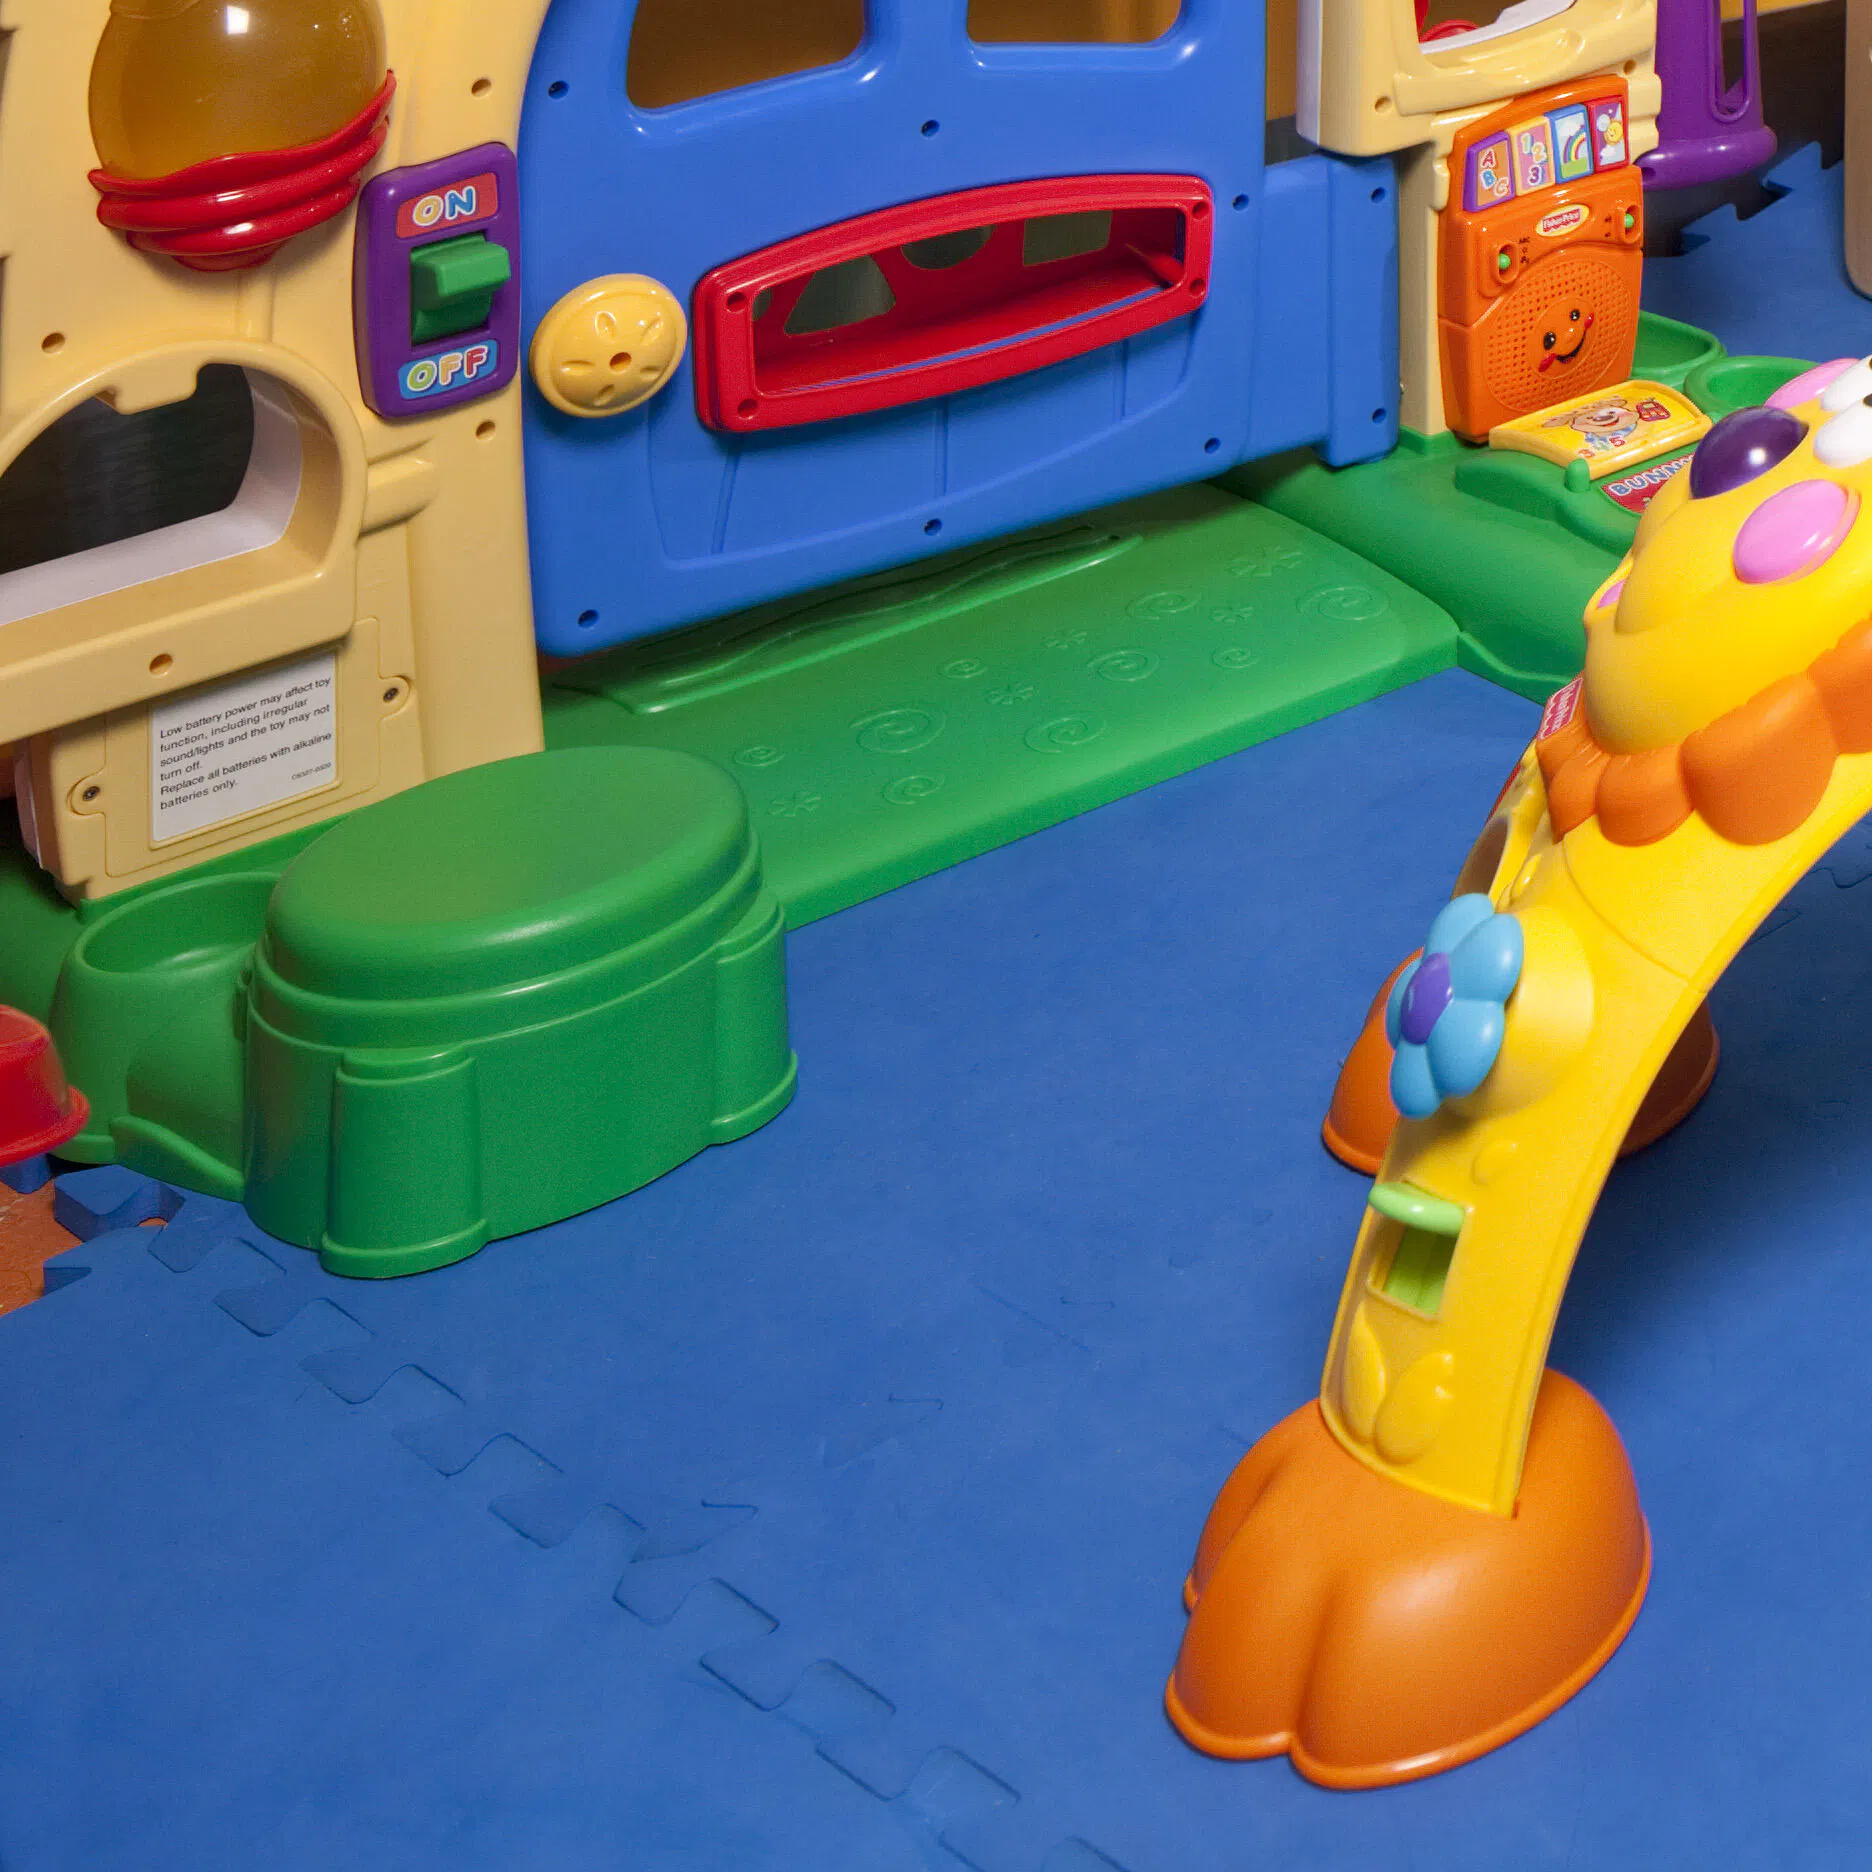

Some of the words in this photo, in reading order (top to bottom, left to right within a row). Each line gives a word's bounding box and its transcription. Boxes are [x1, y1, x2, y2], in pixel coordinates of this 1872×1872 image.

[412, 185, 476, 227] ON
[406, 344, 488, 392] OFF
[160, 727, 183, 739] Low
[186, 713, 223, 731] battery
[225, 702, 258, 720] power
[260, 693, 282, 707] may
[285, 681, 313, 698] affect
[315, 677, 331, 689] toy
[160, 732, 208, 753] function,
[211, 713, 260, 737] including
[263, 698, 308, 720] irregular
[160, 740, 225, 768] sound/lights
[228, 731, 248, 745] and
[250, 725, 267, 739] the
[270, 719, 286, 732] toy
[288, 711, 311, 726] may
[313, 704, 331, 717] not
[160, 774, 206, 797] Replace
[207, 768, 220, 781] all
[222, 753, 268, 777] batteries
[269, 745, 291, 760] with
[292, 731, 332, 753] alkaline
[160, 767, 182, 782] turn
[185, 760, 203, 773] off.
[160, 787, 210, 810] batteries
[212, 778, 239, 794] only.
